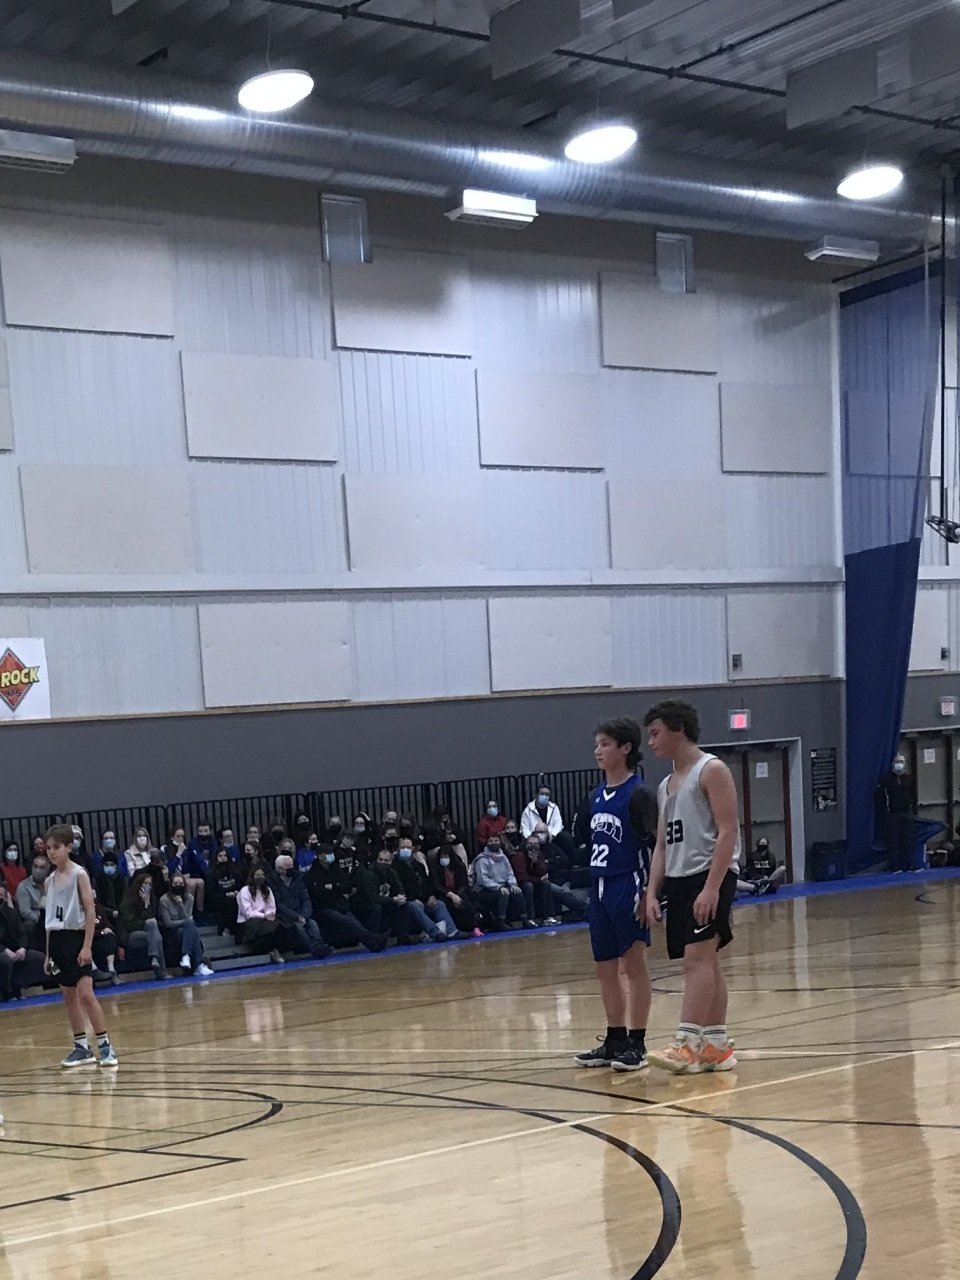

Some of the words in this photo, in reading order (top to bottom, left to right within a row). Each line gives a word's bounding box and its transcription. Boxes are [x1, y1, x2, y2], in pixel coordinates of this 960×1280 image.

[666, 819, 684, 845] 33
[590, 844, 609, 867] 22
[55, 905, 63, 922] 4
